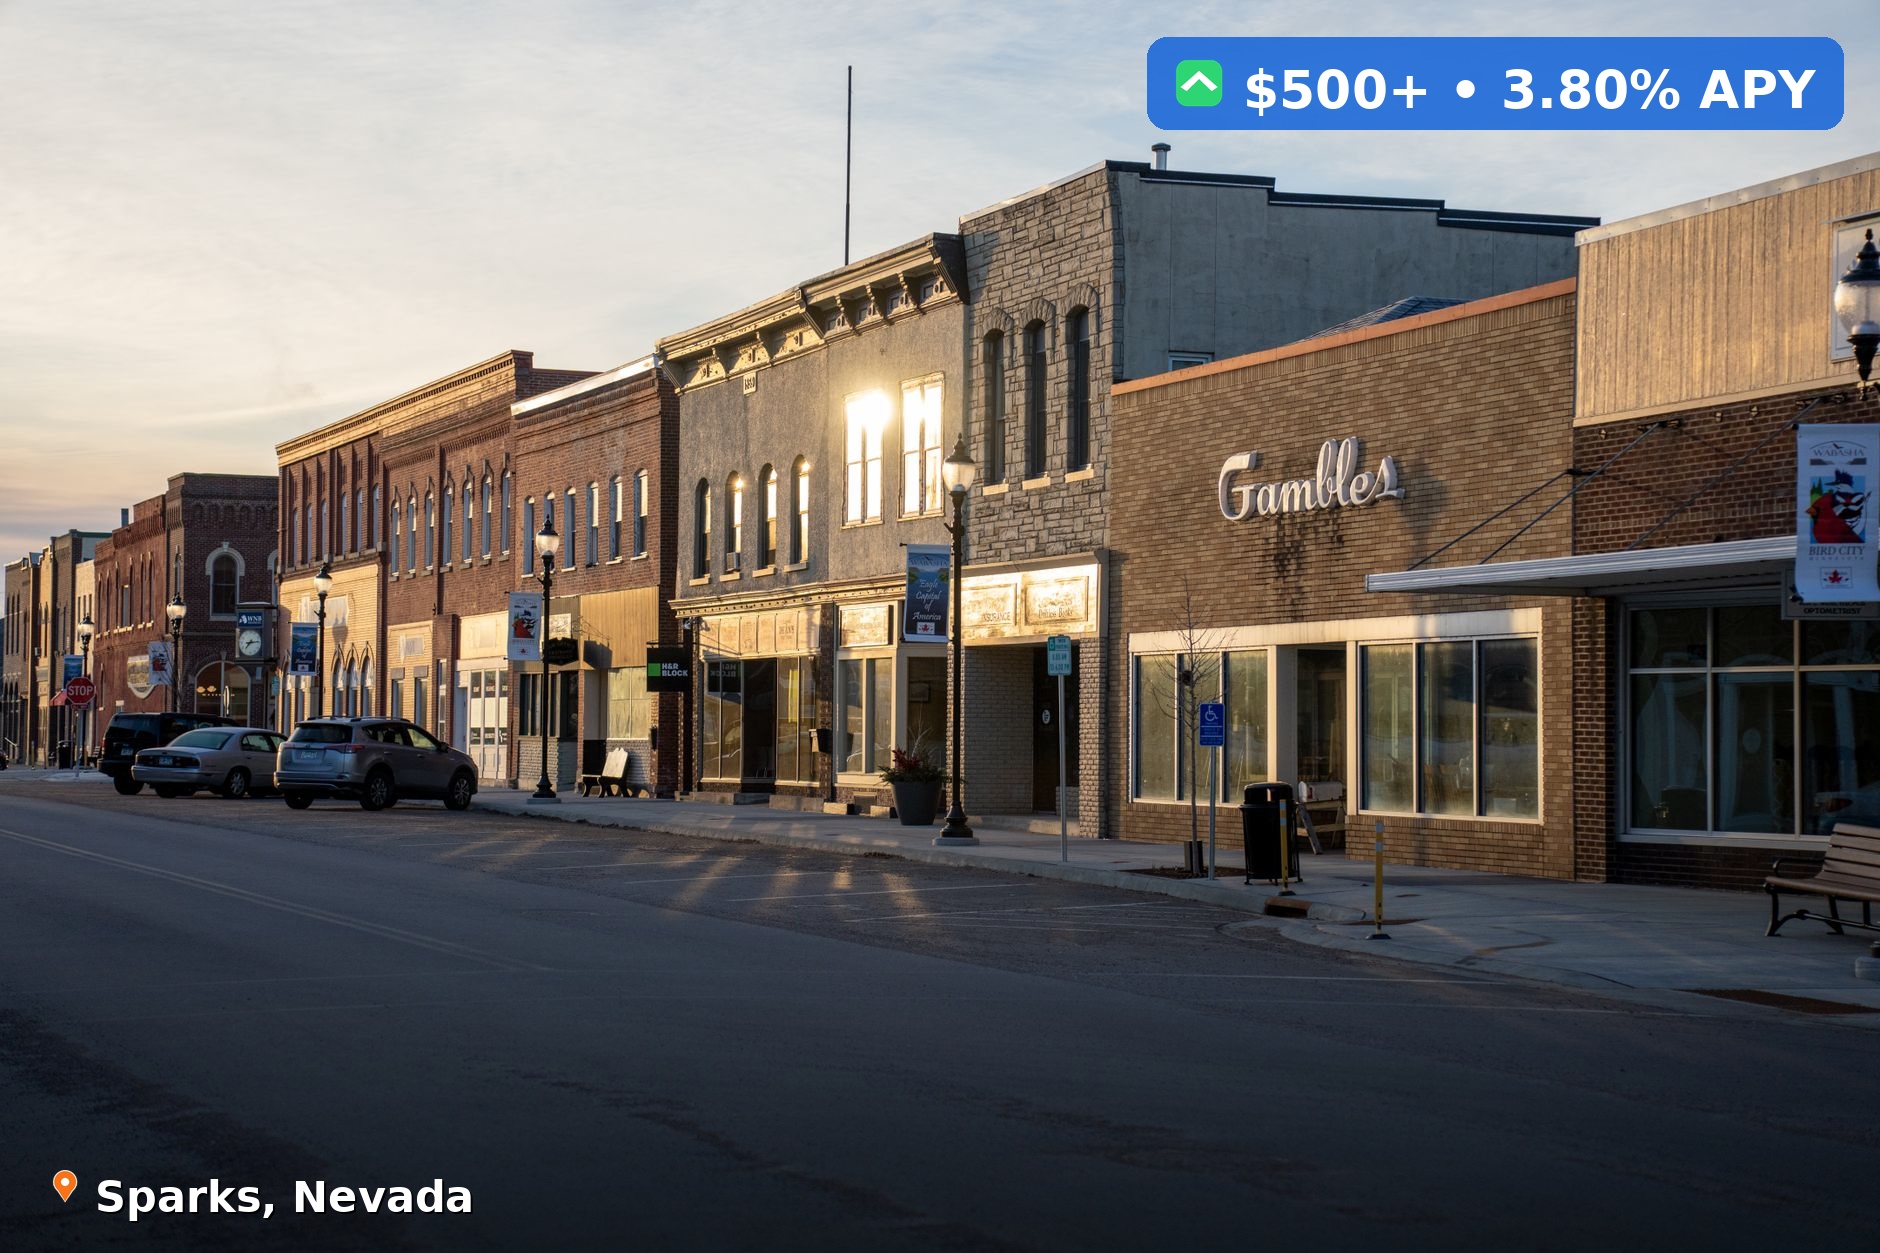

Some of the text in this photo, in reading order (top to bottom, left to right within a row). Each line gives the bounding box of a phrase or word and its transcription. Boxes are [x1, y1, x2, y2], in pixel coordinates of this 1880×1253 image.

[1813, 448, 1865, 457] WABASHA
[1218, 436, 1406, 522] Gambles
[1808, 545, 1865, 556] BIRD CITY
[920, 579, 938, 592] Eagle
[916, 591, 942, 603] Capital
[924, 600, 934, 612] of
[1803, 607, 1862, 615] OPTOMETRIST
[912, 611, 942, 620] America
[68, 685, 94, 696] STOP
